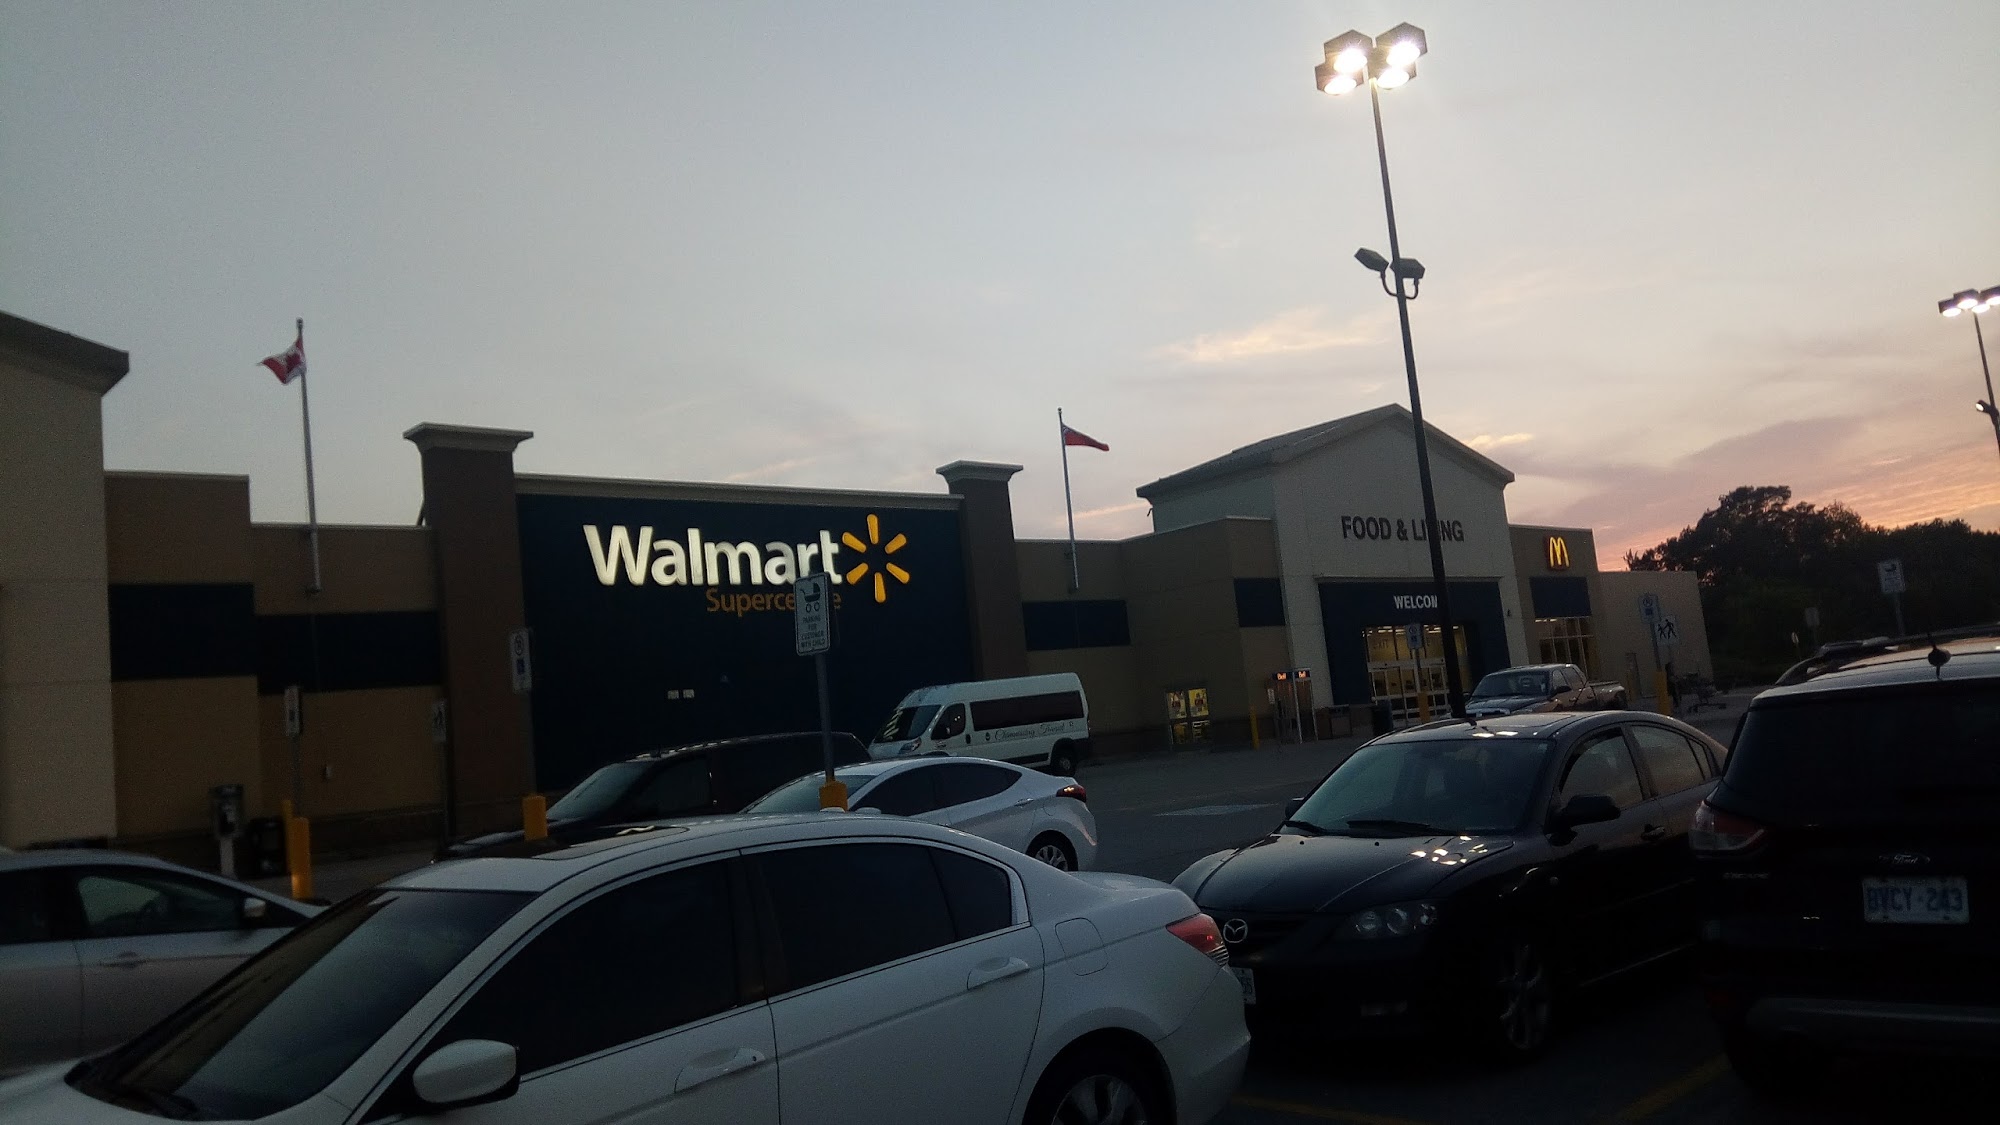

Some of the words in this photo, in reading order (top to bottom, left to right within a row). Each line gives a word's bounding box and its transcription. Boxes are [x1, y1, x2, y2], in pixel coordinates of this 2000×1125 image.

[1341, 515, 1392, 540] FOOD
[1396, 518, 1409, 541] &
[1411, 519, 1465, 542] LING
[582, 523, 843, 586] Walmart
[706, 588, 841, 616] Supercee
[1393, 594, 1438, 609] WELCOM
